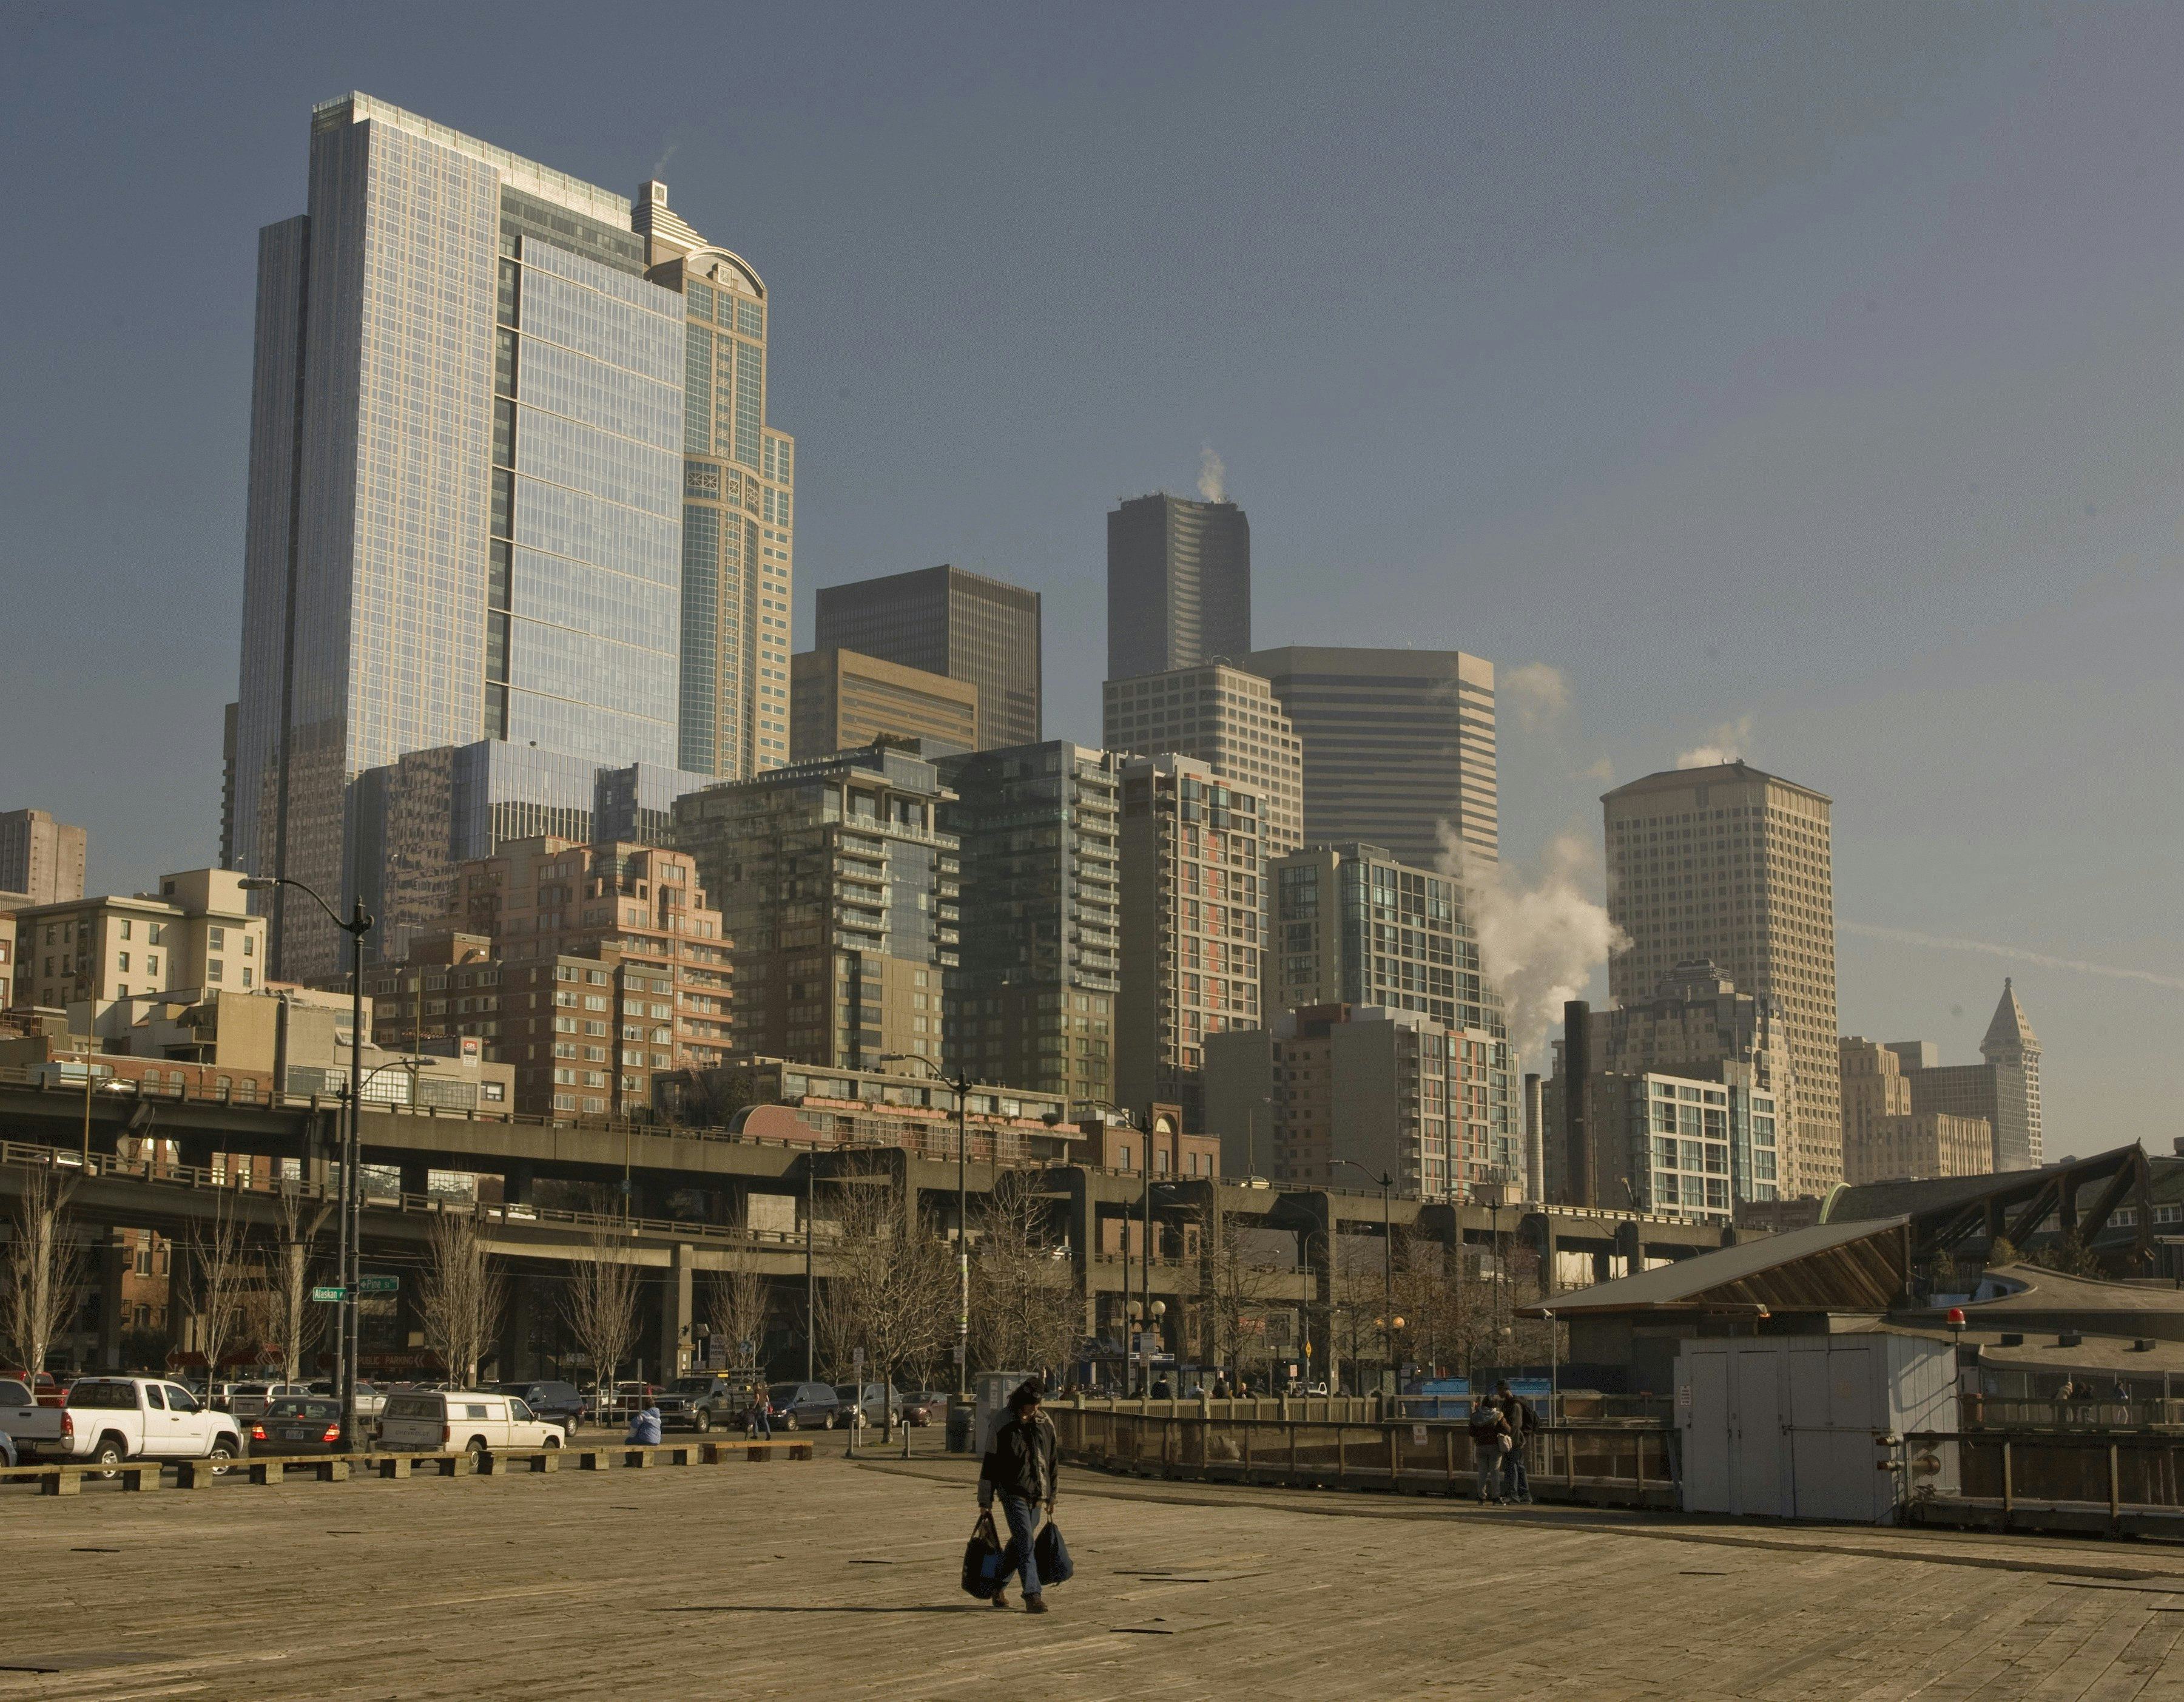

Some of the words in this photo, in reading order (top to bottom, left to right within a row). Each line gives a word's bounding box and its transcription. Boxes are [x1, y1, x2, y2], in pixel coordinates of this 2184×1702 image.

[367, 1279, 381, 1289] Pine
[315, 1289, 337, 1298] Alaskan
[359, 1356, 379, 1365] PUBLIC
[385, 1356, 413, 1365] PARKING
